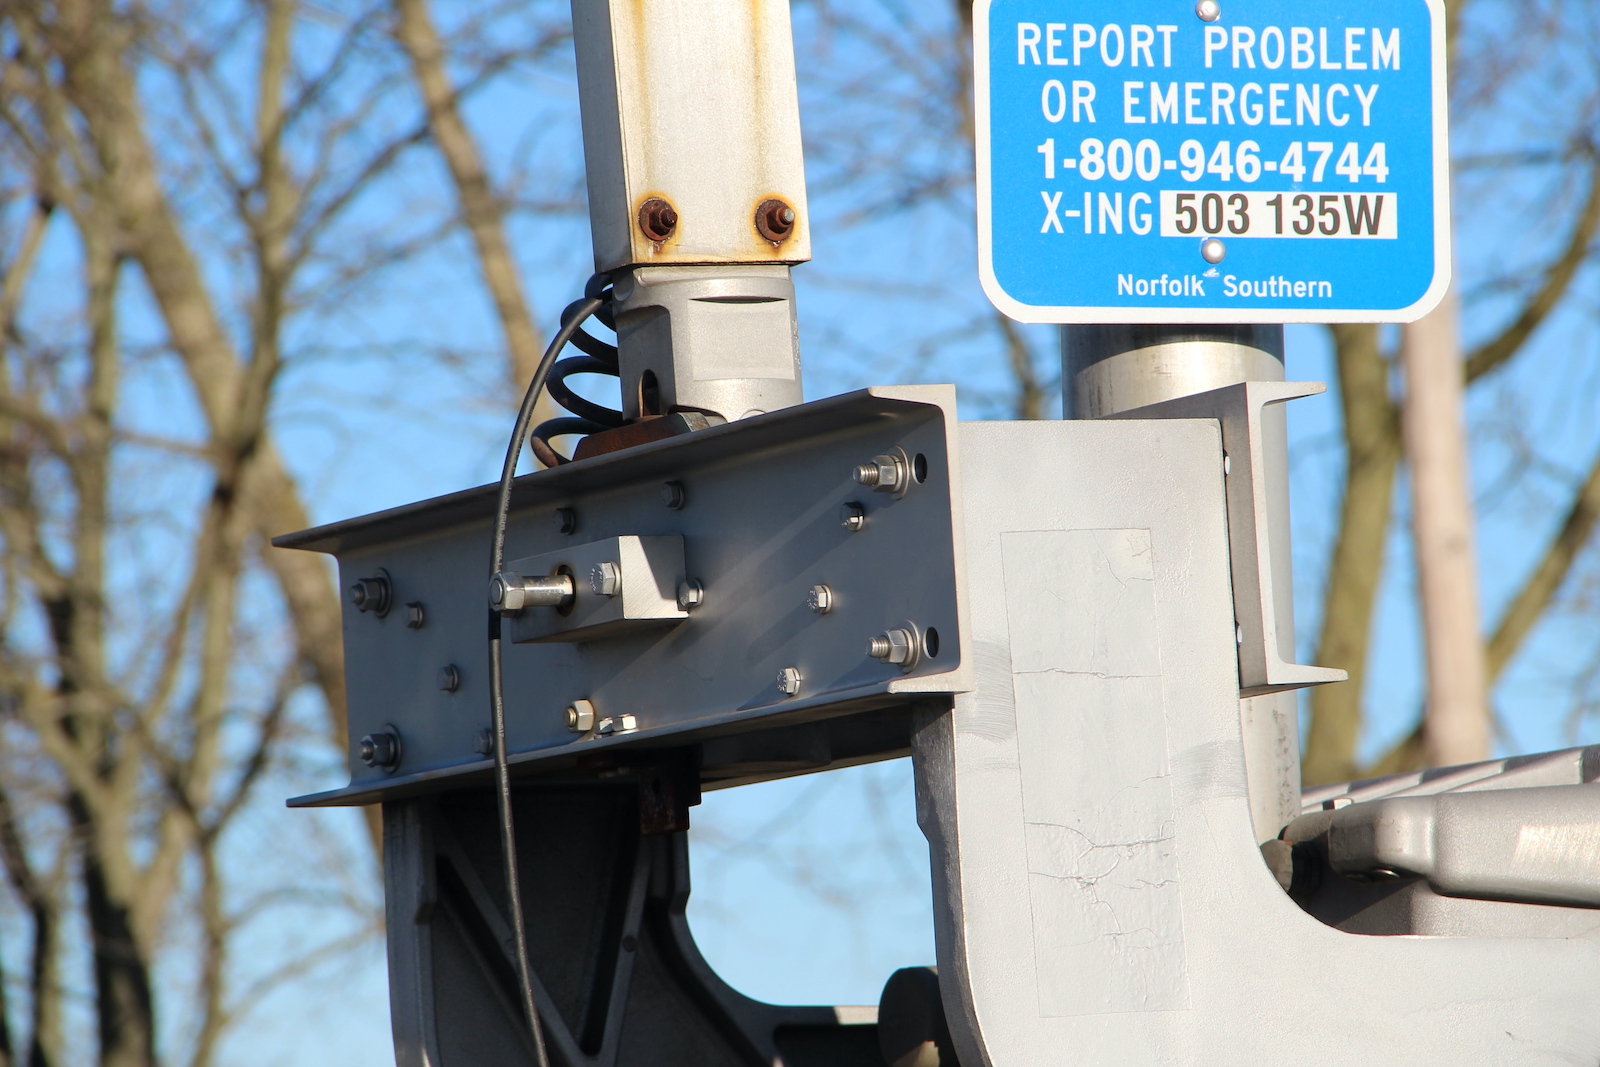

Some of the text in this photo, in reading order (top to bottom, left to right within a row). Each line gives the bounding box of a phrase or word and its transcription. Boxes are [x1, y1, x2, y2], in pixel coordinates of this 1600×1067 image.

[1017, 23, 1401, 71] REPORT PROBLEM
[1041, 80, 1379, 127] OR EMERGENCY
[1037, 138, 1389, 183] 1-800-946-4744
[1040, 191, 1384, 236] X-ING 503 135W
[1117, 274, 1332, 298] Norfolk Southern
